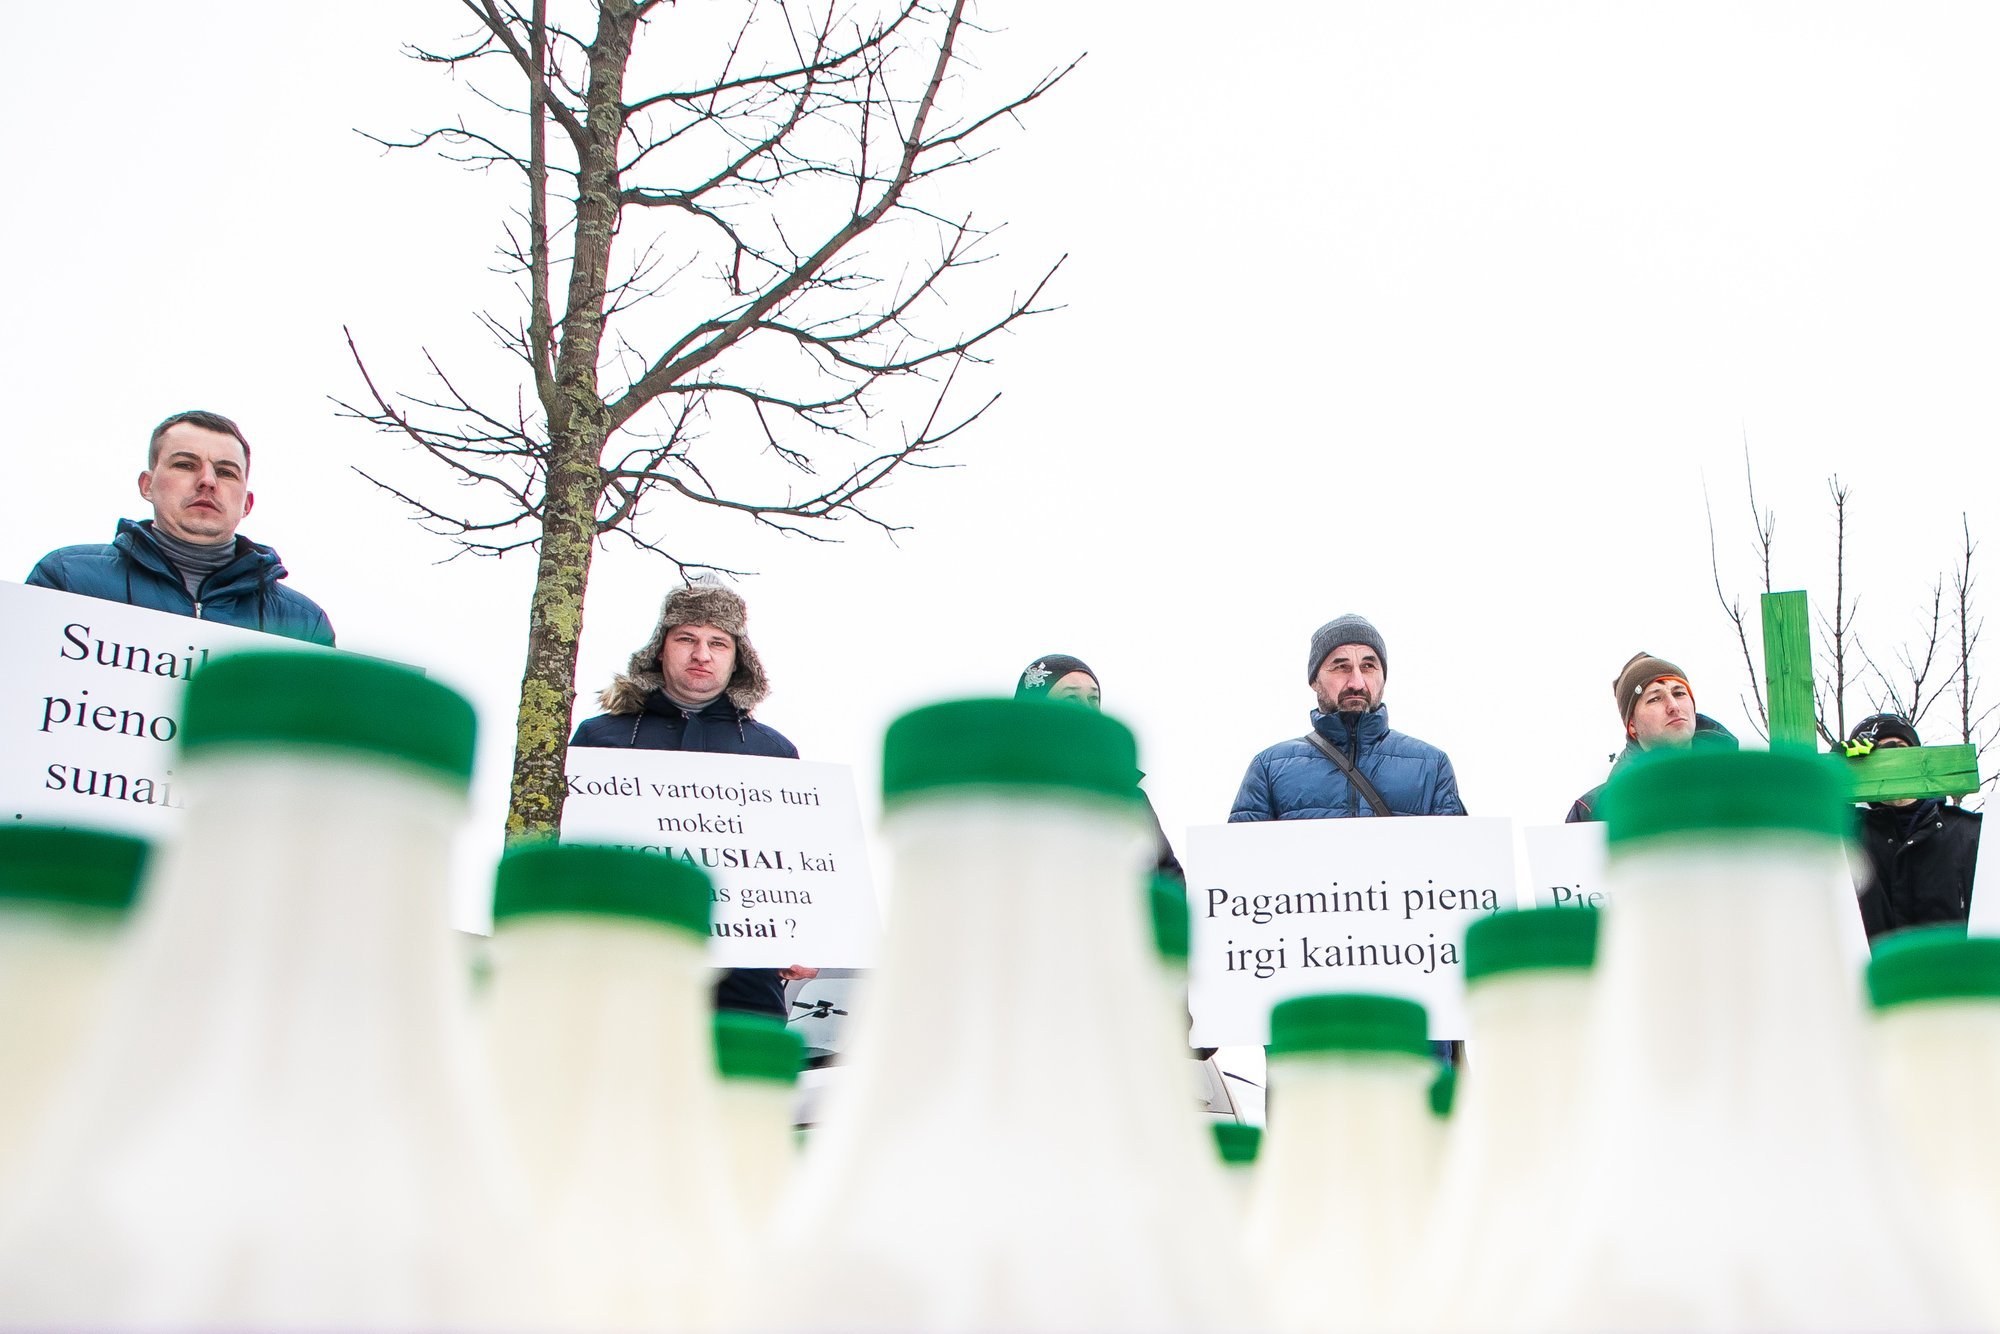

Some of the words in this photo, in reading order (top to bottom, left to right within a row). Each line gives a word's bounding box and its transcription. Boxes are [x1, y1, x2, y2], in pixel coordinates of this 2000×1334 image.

[38, 689, 178, 743] pieno
[45, 763, 186, 810] sunai
[565, 774, 643, 798] Kodėl
[650, 780, 772, 807] vartotojas
[780, 785, 821, 806] turi
[657, 813, 744, 835] mokėti
[800, 850, 836, 873] kai
[740, 888, 813, 909] gauna
[1205, 880, 1390, 926] Pagaminti
[1402, 879, 1501, 920] pieną
[784, 917, 797, 939] ?
[1225, 939, 1287, 979] irgi
[1300, 934, 1461, 974] kainuoja
